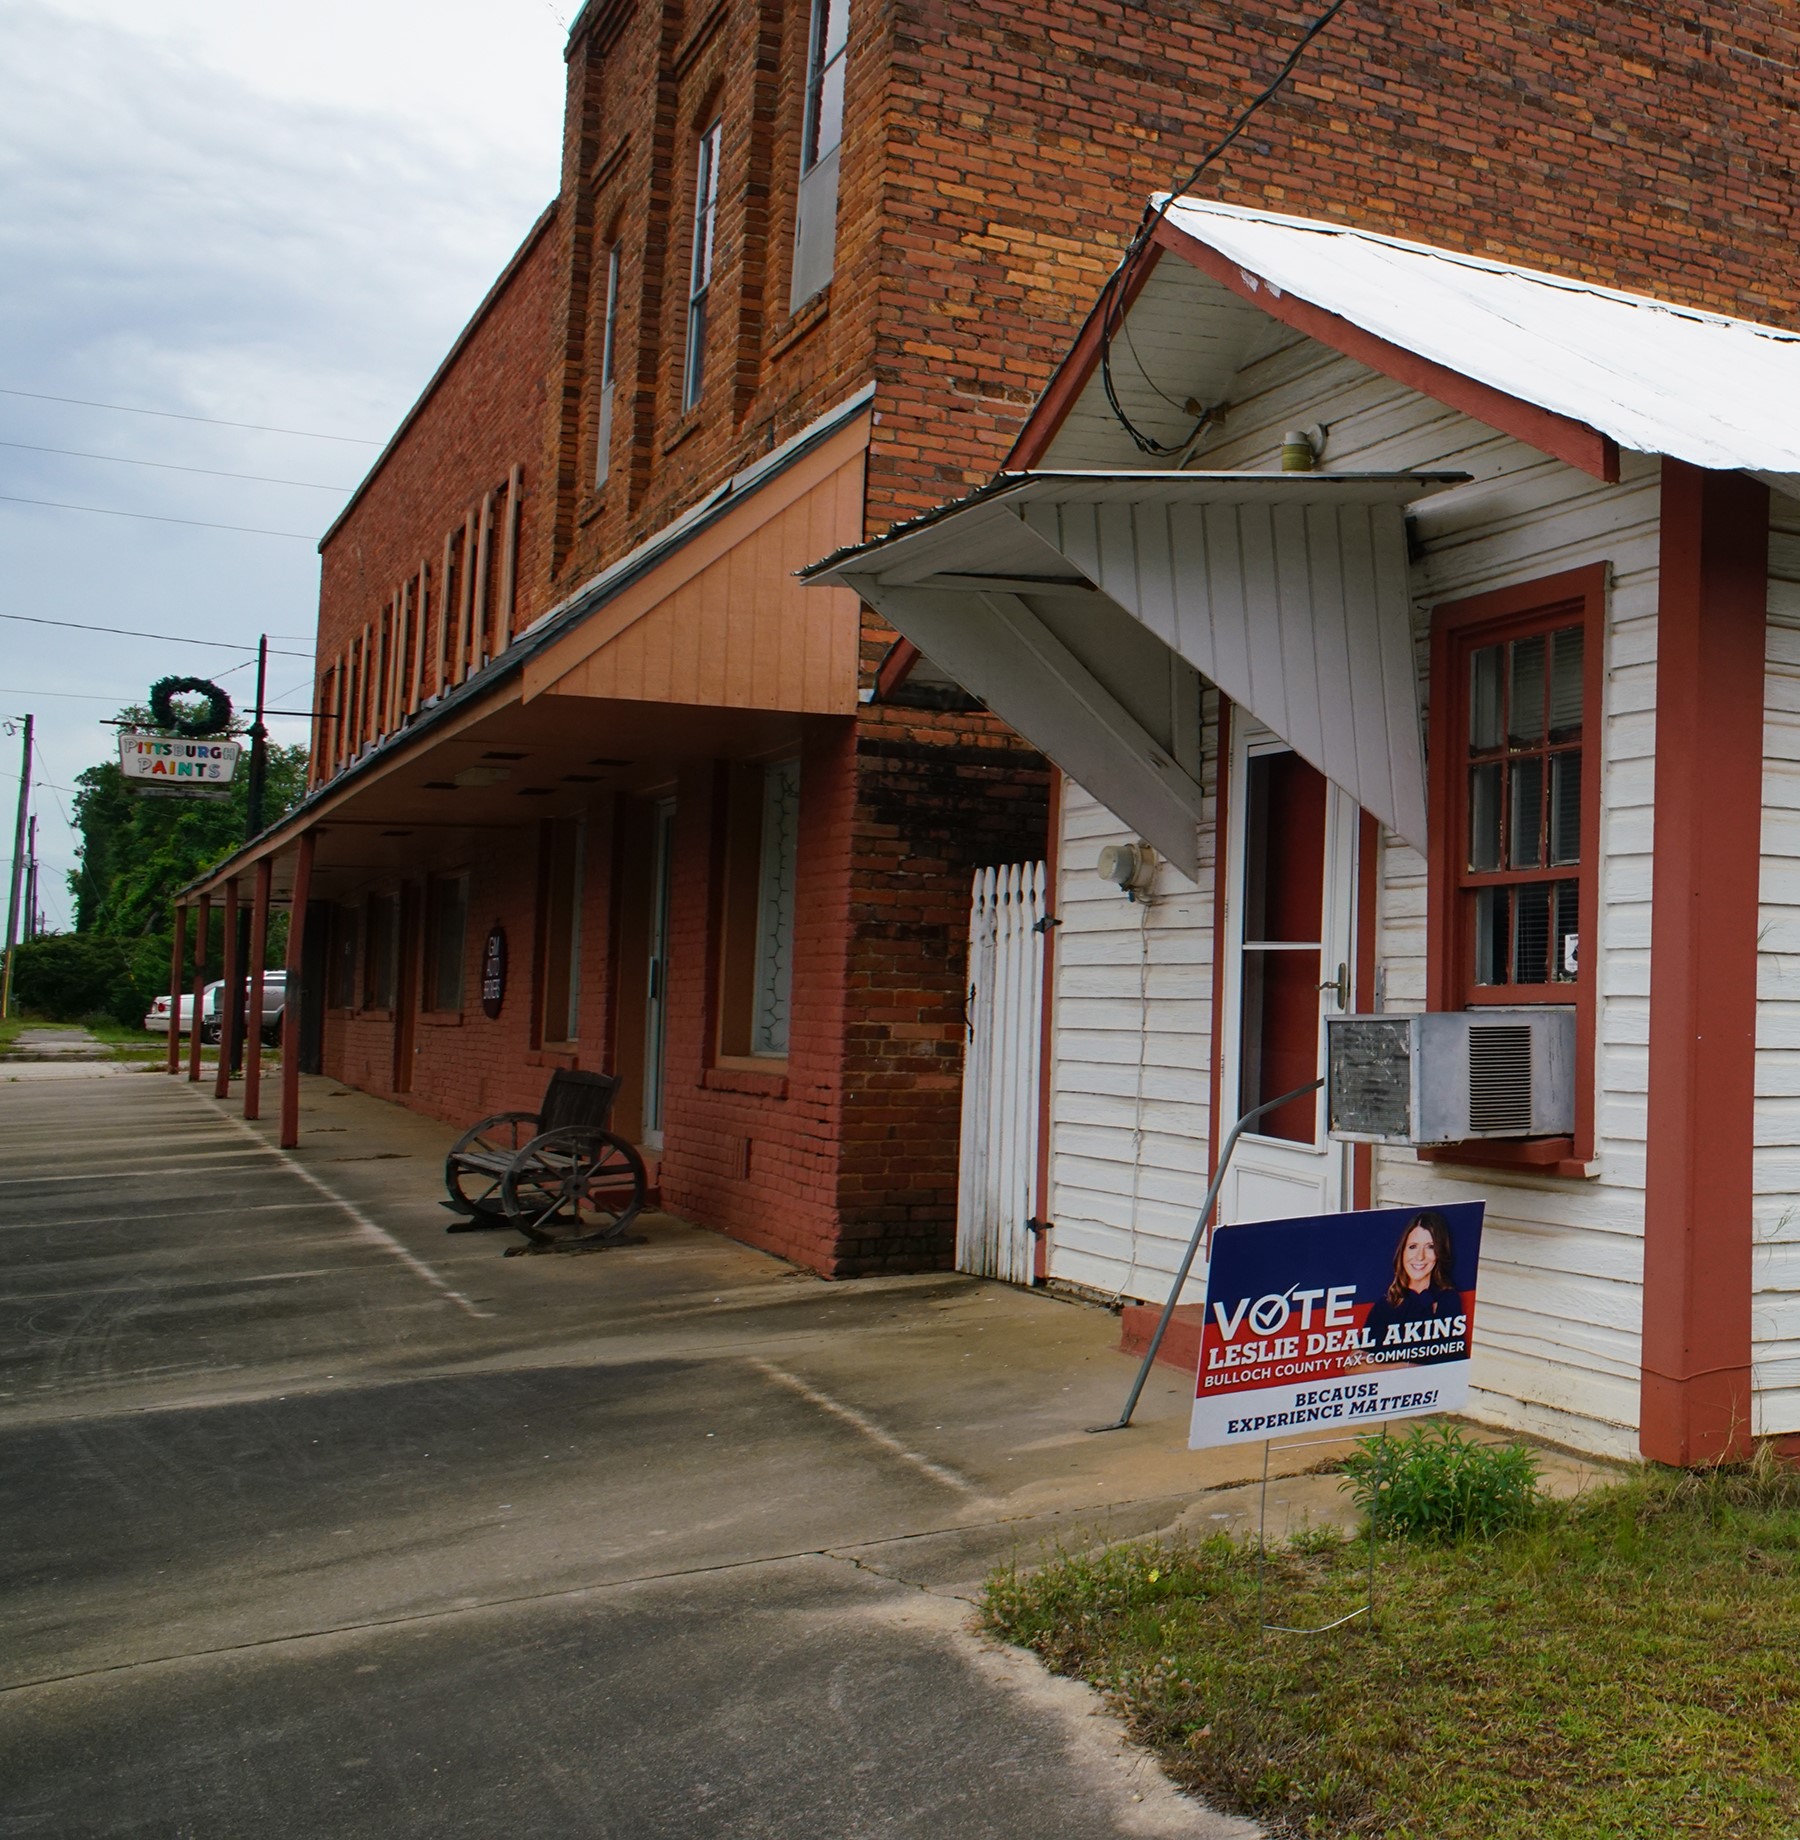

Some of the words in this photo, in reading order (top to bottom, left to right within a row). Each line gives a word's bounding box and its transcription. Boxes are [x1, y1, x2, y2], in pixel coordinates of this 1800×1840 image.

[124, 739, 235, 761] PITTSBURGH
[138, 758, 221, 778] PAINTS
[1213, 1283, 1357, 1341] VOTE
[1203, 1366, 1271, 1388] BULLOCH
[1275, 1358, 1333, 1378] COUNTY
[1335, 1354, 1362, 1369] TAX
[1364, 1340, 1465, 1365] COMMISSIONER
[1207, 1335, 1299, 1370] LESLIE
[1306, 1327, 1376, 1357] DEAL
[1382, 1314, 1467, 1346] AKINS
[1227, 1402, 1343, 1434] EXPERIENCE
[1348, 1390, 1439, 1416] MATTERS!
[1295, 1382, 1379, 1407] BECAUSE
